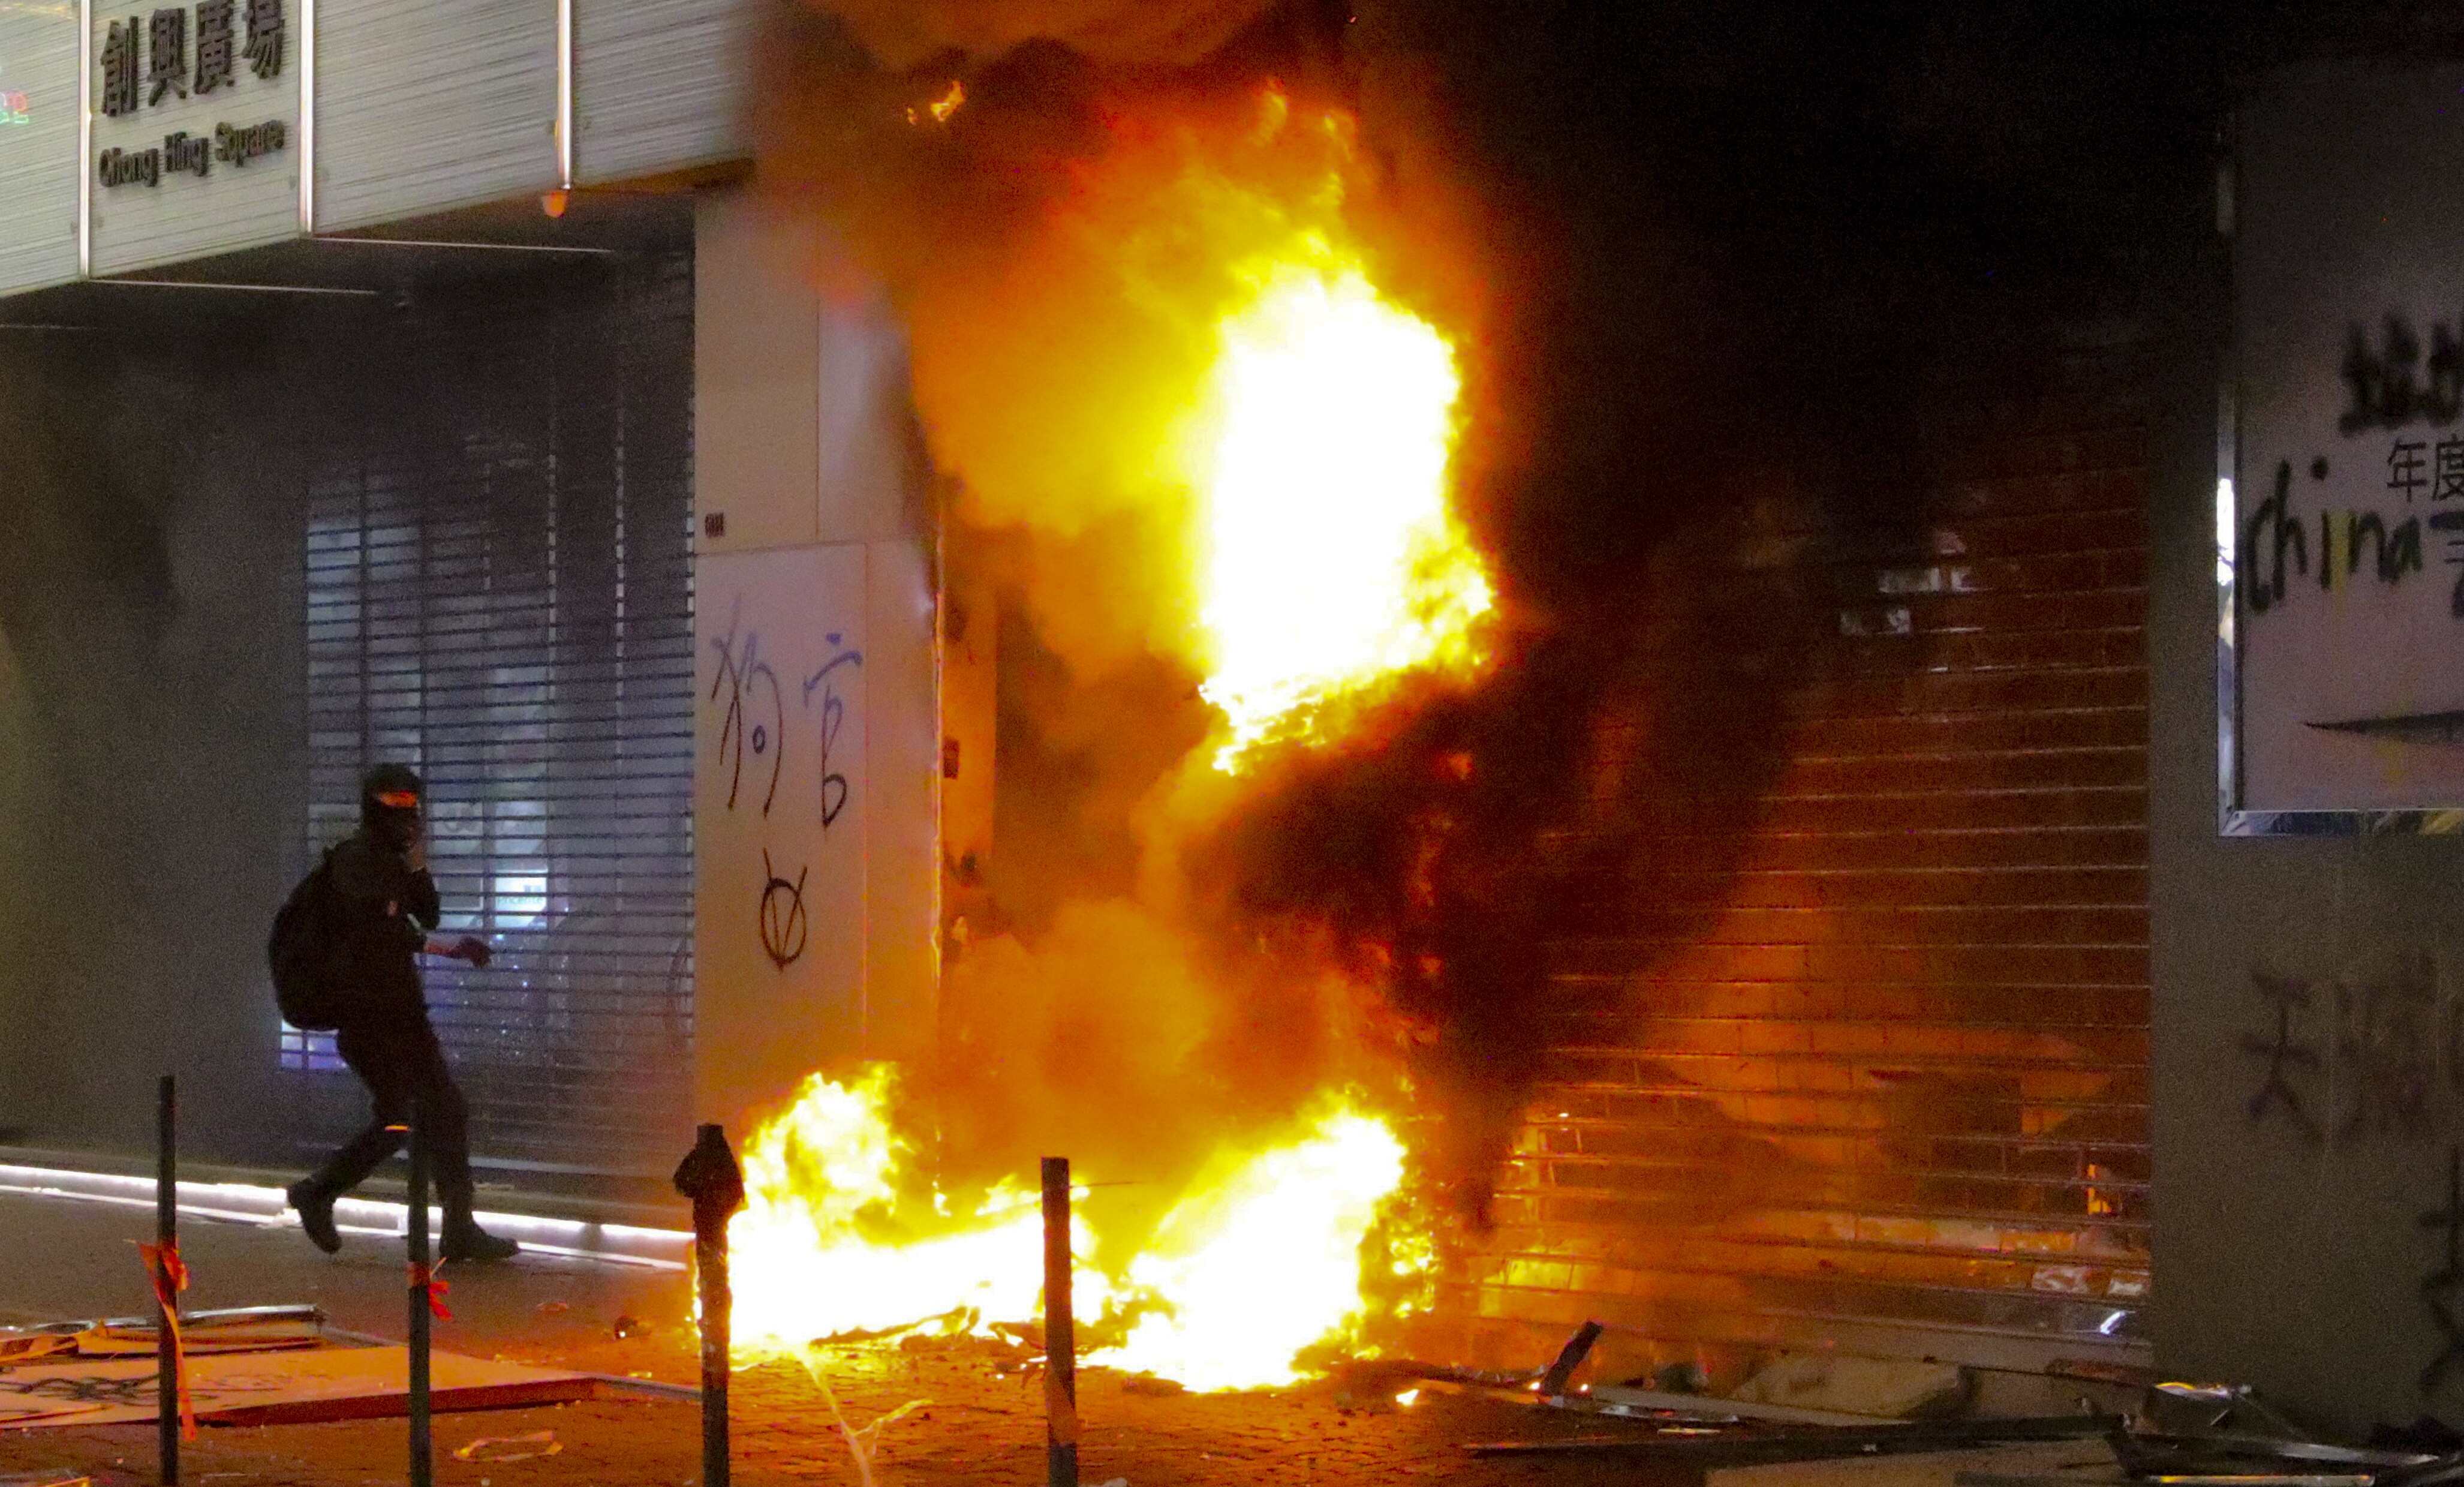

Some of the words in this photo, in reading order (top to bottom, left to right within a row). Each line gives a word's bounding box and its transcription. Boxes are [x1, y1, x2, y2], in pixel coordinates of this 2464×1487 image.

[100, 0, 285, 117] 創興廣場
[99, 148, 158, 187] Chong
[164, 131, 209, 177] Hing
[214, 119, 285, 167] Square
[2386, 433, 2464, 503] 年度
